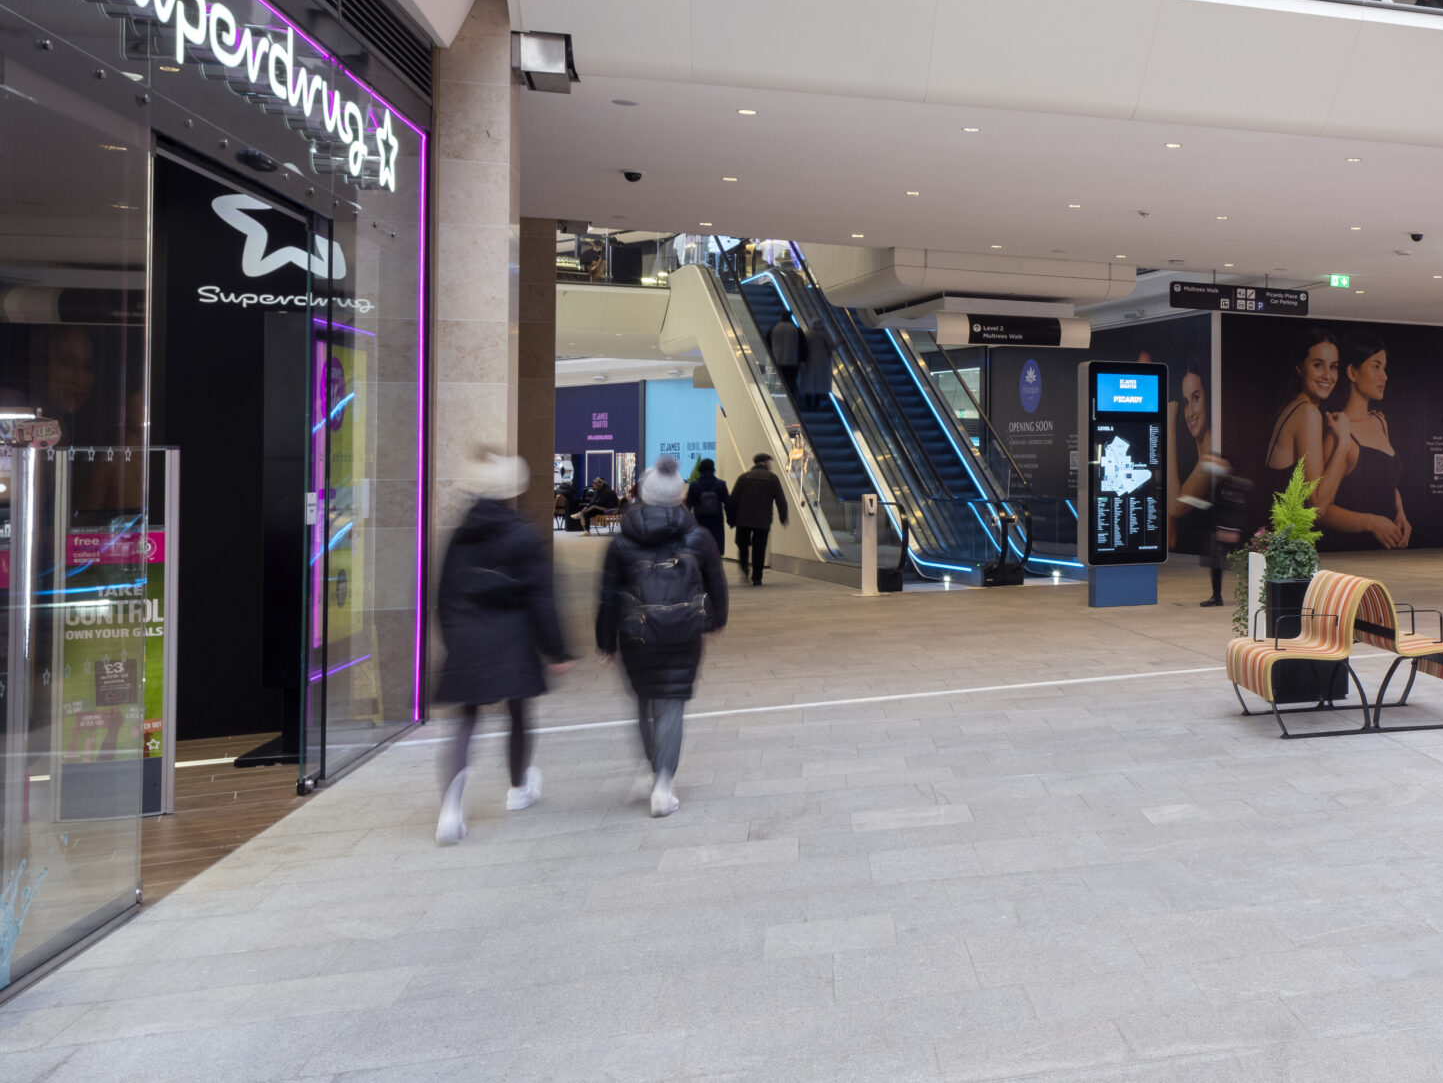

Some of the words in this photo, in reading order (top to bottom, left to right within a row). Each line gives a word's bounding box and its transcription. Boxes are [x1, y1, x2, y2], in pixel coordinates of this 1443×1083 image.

[197, 285, 375, 313] Superdrug
[1280, 299, 1298, 307] Parking
[1008, 421, 1035, 432] OPENING
[1035, 421, 1053, 432] SOON
[73, 536, 100, 546] free
[73, 550, 101, 558] collect
[66, 629, 94, 640] OWN
[95, 628, 129, 638] YOUR
[105, 661, 125, 674] £3
